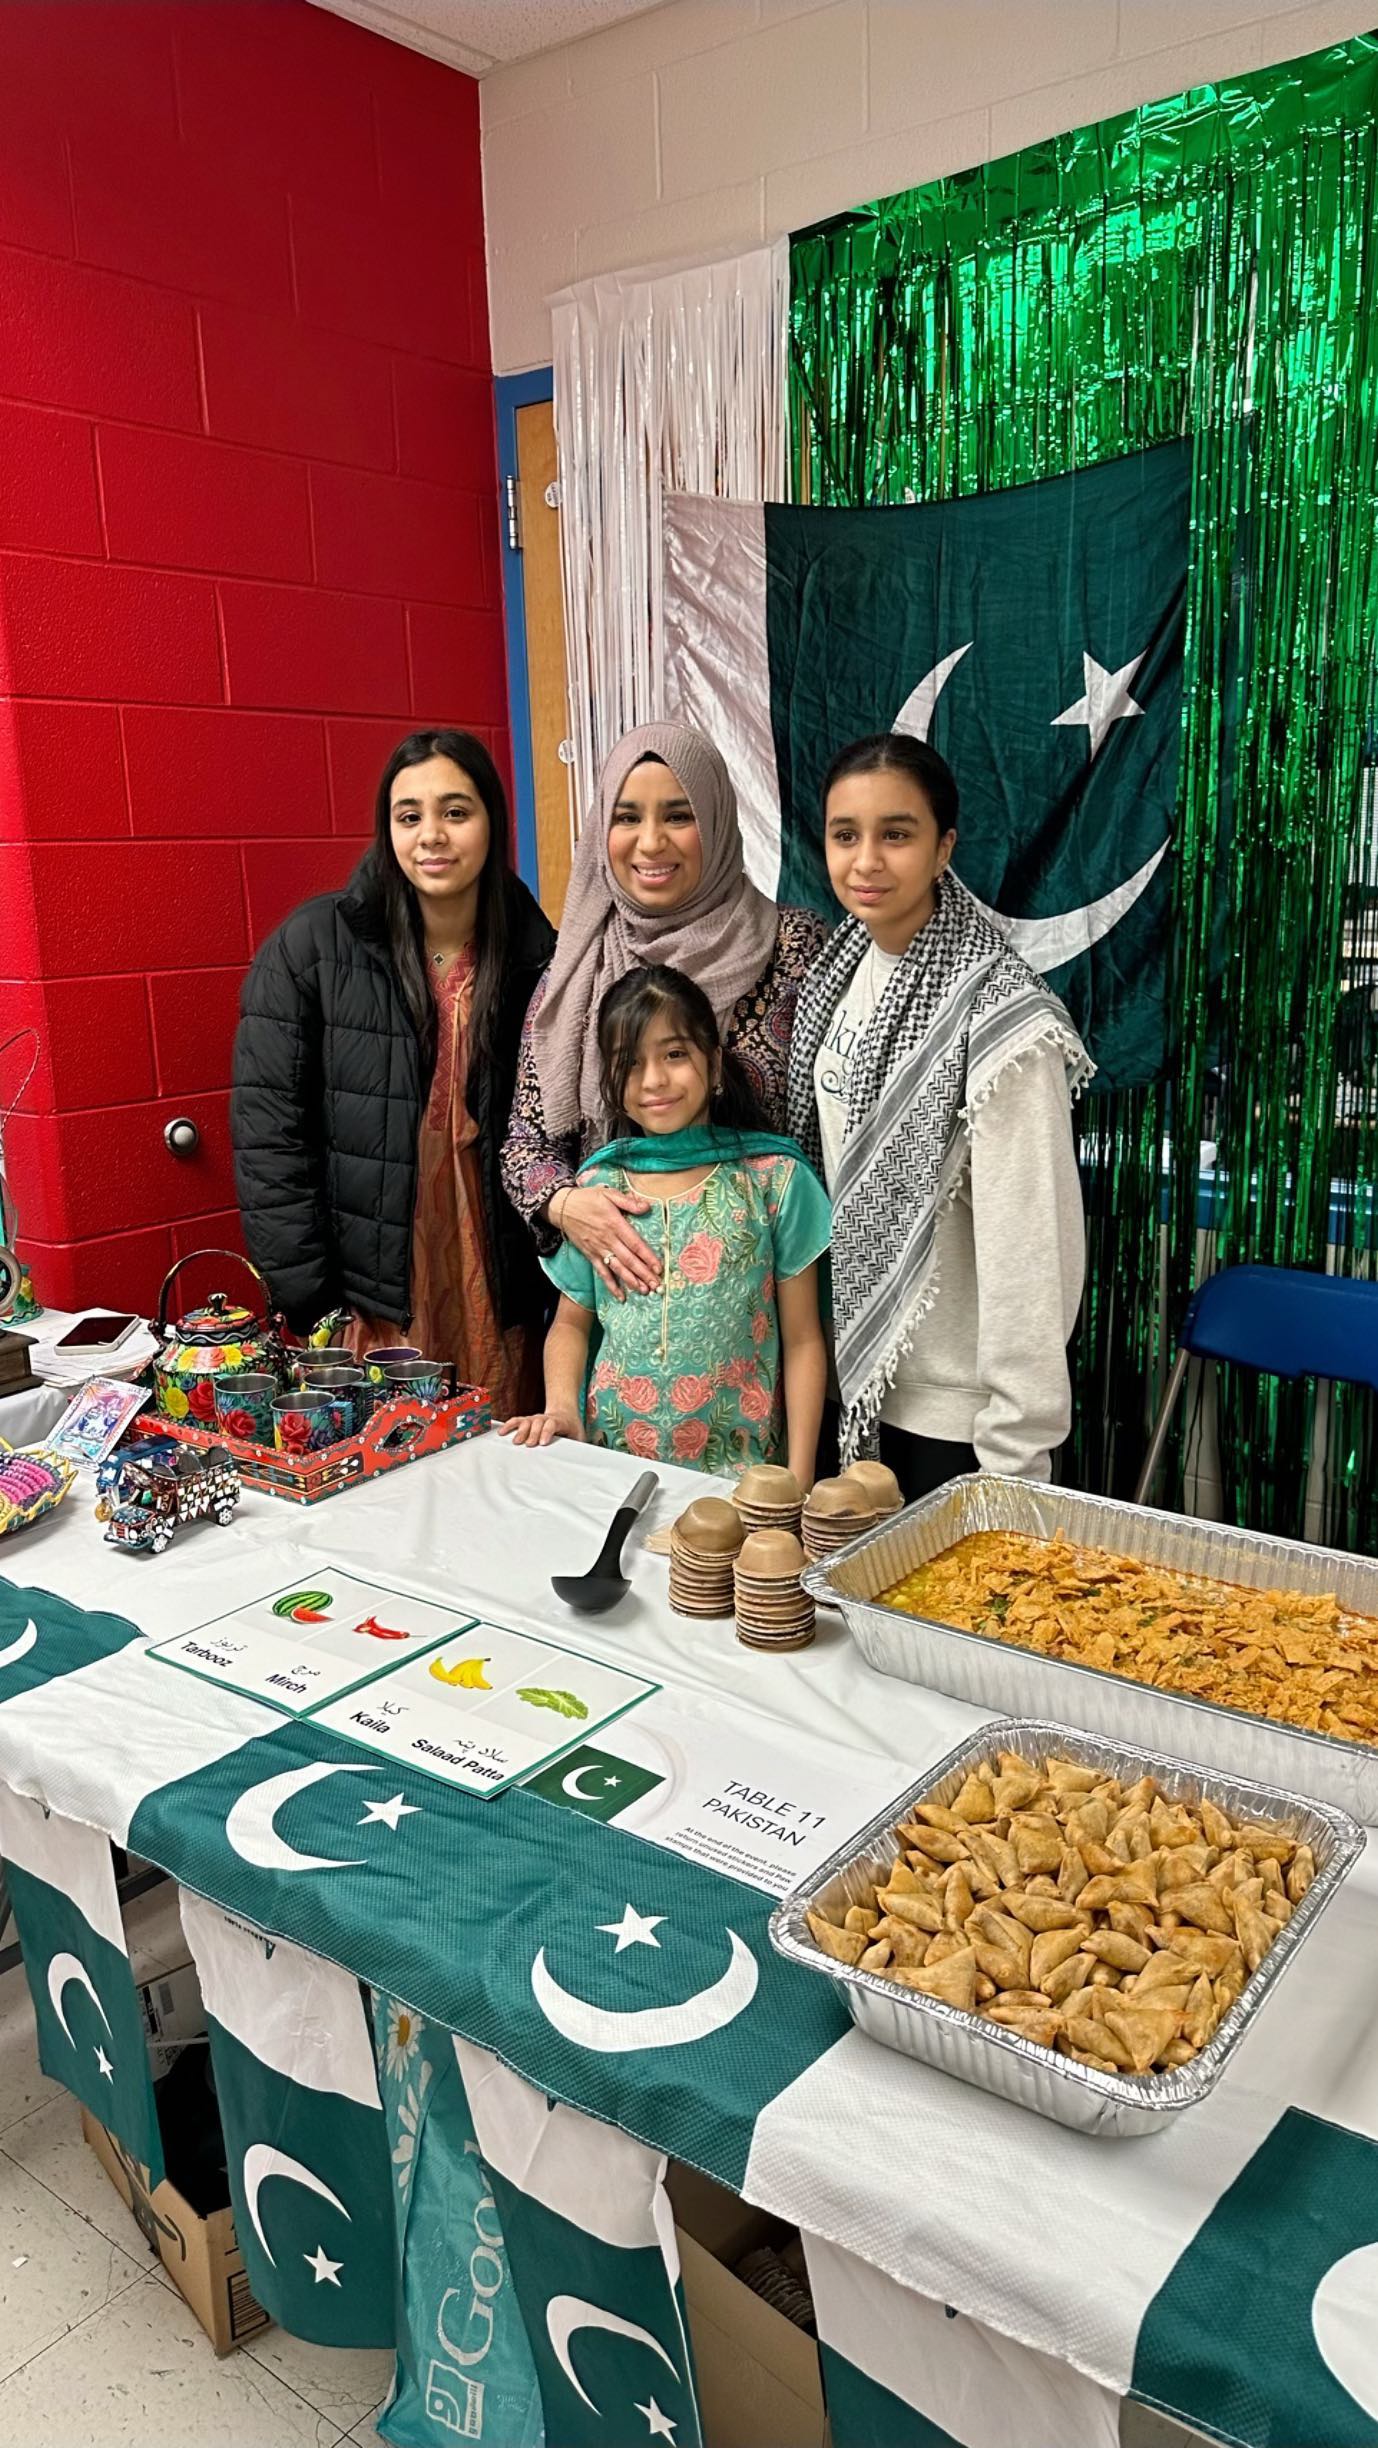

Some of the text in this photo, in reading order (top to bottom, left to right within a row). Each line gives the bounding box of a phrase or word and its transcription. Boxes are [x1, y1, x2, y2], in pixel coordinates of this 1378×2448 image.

[181, 1641, 234, 1667] Tarbooz
[265, 1673, 307, 1694] Mirch
[350, 1711, 391, 1734] Kaila
[411, 1738, 505, 1782] Salaad Patta
[702, 1798, 807, 1846] PAKISTAN
[723, 1780, 827, 1829] TABLE 11
[665, 1836, 693, 1851] stamps
[693, 1848, 710, 1858] that
[709, 1856, 729, 1866] were
[728, 1864, 764, 1881] provided
[772, 1883, 789, 1892] you
[675, 1832, 699, 1845] return
[699, 1842, 728, 1857] unused
[728, 1855, 758, 1870] stickers
[758, 1868, 776, 1877] and
[694, 1831, 707, 1839] the
[707, 1837, 723, 1846] end
[731, 1847, 745, 1855] the
[769, 1864, 797, 1877] please
[437, 2138, 505, 2367] Goo
